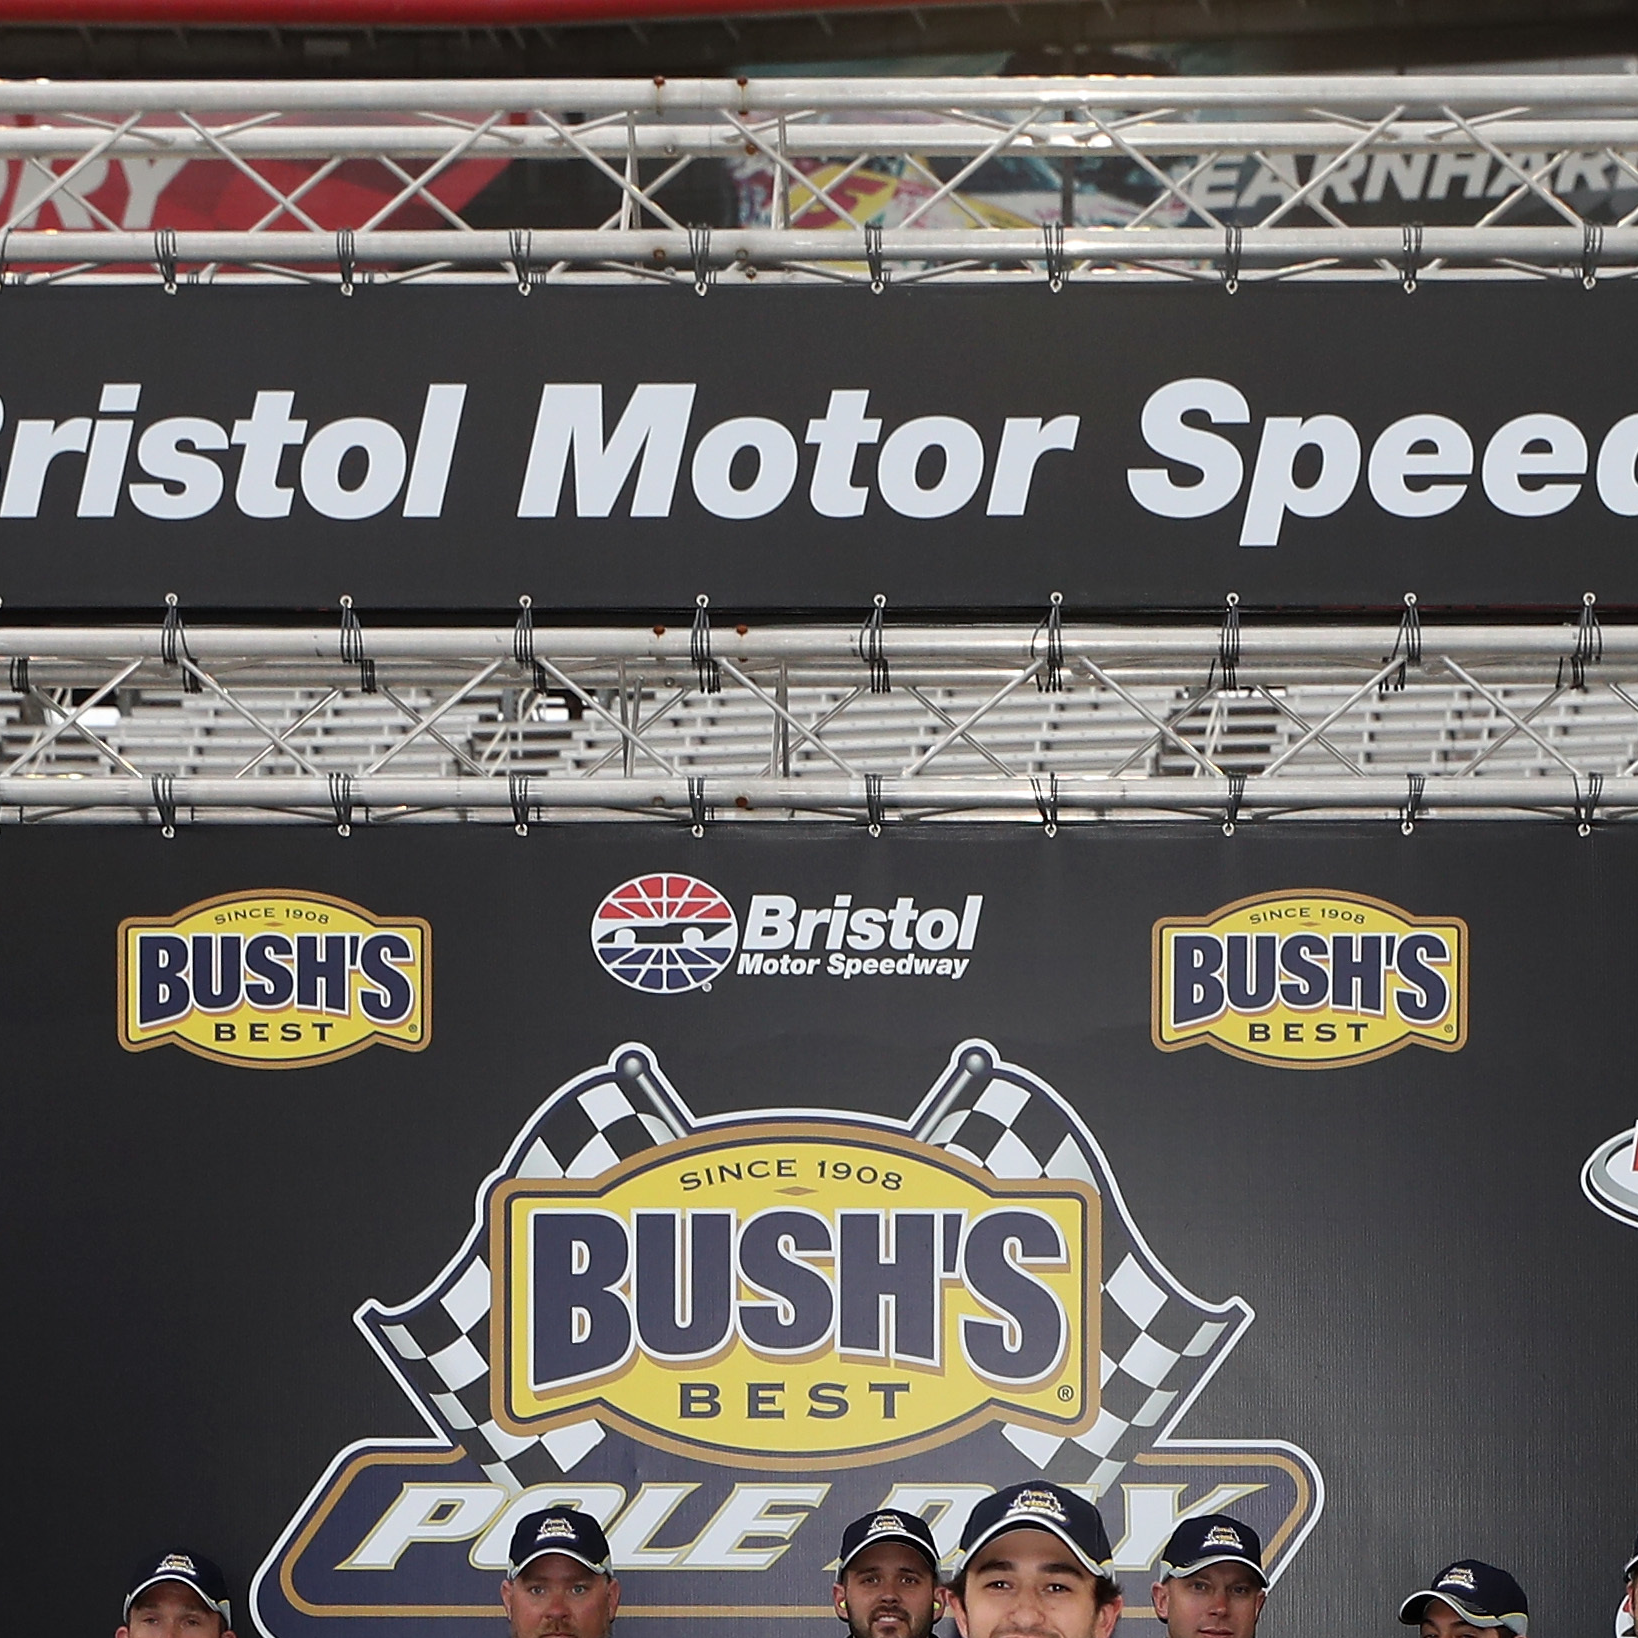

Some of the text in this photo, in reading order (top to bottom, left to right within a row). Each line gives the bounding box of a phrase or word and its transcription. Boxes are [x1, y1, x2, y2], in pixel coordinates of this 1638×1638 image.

[518, 382, 1080, 521] Motor
[213, 906, 330, 927] SINCE 1908
[743, 893, 984, 954] Bristol
[1250, 907, 1366, 926] SINCE 1908
[137, 932, 417, 1030] BUSH'S
[736, 952, 971, 982] Motor Speedway
[1171, 931, 1450, 1030] BUSH'S
[212, 1022, 335, 1044] BEST
[1248, 1022, 1369, 1043] BEST
[679, 1157, 906, 1194] SINCE 1908
[523, 1204, 1072, 1395] BUSH'S
[679, 1381, 911, 1421] BEST
